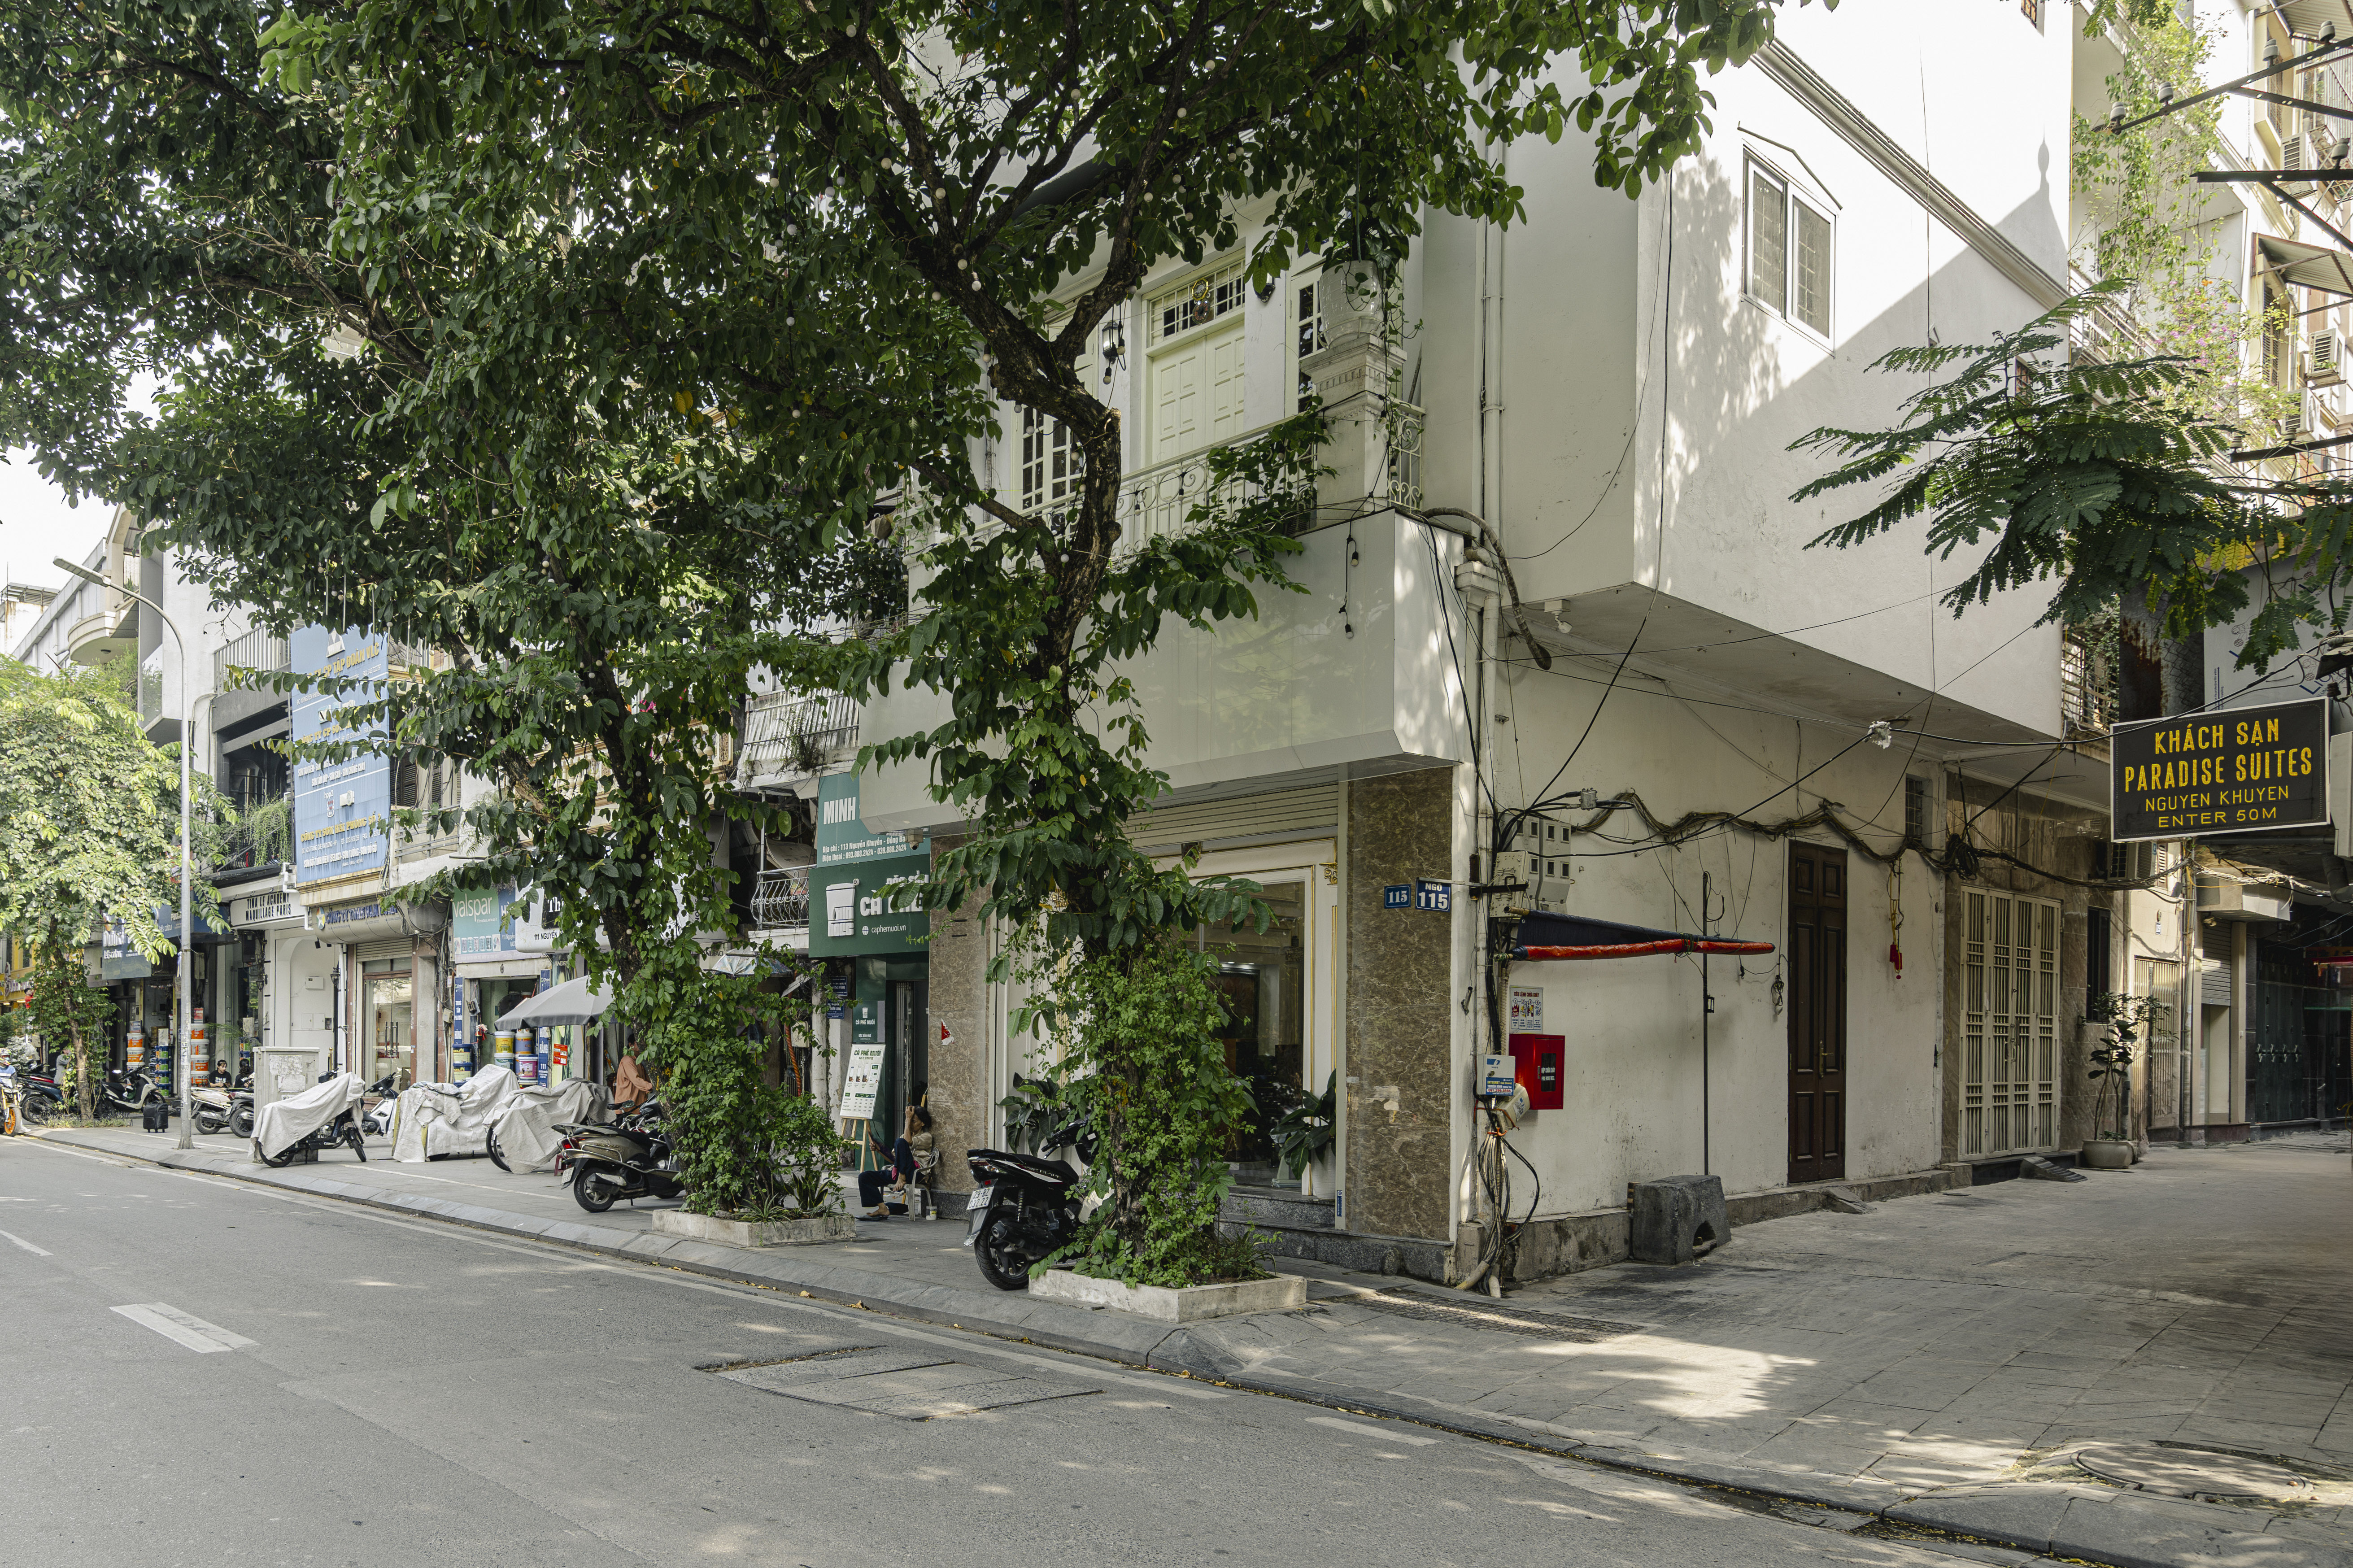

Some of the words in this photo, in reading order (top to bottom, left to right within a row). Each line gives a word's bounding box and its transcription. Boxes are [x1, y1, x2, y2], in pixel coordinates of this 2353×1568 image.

[366, 642, 380, 659] VLC
[2155, 723, 2224, 754] KHÁCH
[2236, 718, 2279, 746] SẠN
[2125, 756, 2225, 793] PARADISE
[2236, 747, 2313, 782] SUITES
[324, 790, 334, 800] hpp2
[2146, 793, 2210, 812] NGUYEN
[2220, 785, 2289, 805] KHUYEN
[824, 797, 856, 825] MINH
[2158, 811, 2227, 828] ENTER
[2237, 807, 2277, 822] 50M
[822, 854, 831, 863] Điện
[832, 853, 842, 862] thoại
[845, 848, 873, 859] 093.888.2424
[877, 844, 906, 855] 039.888.2424
[1425, 883, 1442, 892] NGÕ
[247, 897, 257, 909] TINA
[260, 896, 265, 907] LE
[267, 893, 290, 905] ACADEMY
[860, 889, 882, 916] CÀ
[1389, 890, 1407, 903] 115
[1419, 892, 1447, 909] 115
[245, 906, 274, 921] MAQUILLAGE
[277, 904, 291, 916] PARIS
[453, 893, 492, 922] valspar
[871, 924, 906, 935] caphemuoi.vn
[969, 1197, 989, 1208] 032.22
